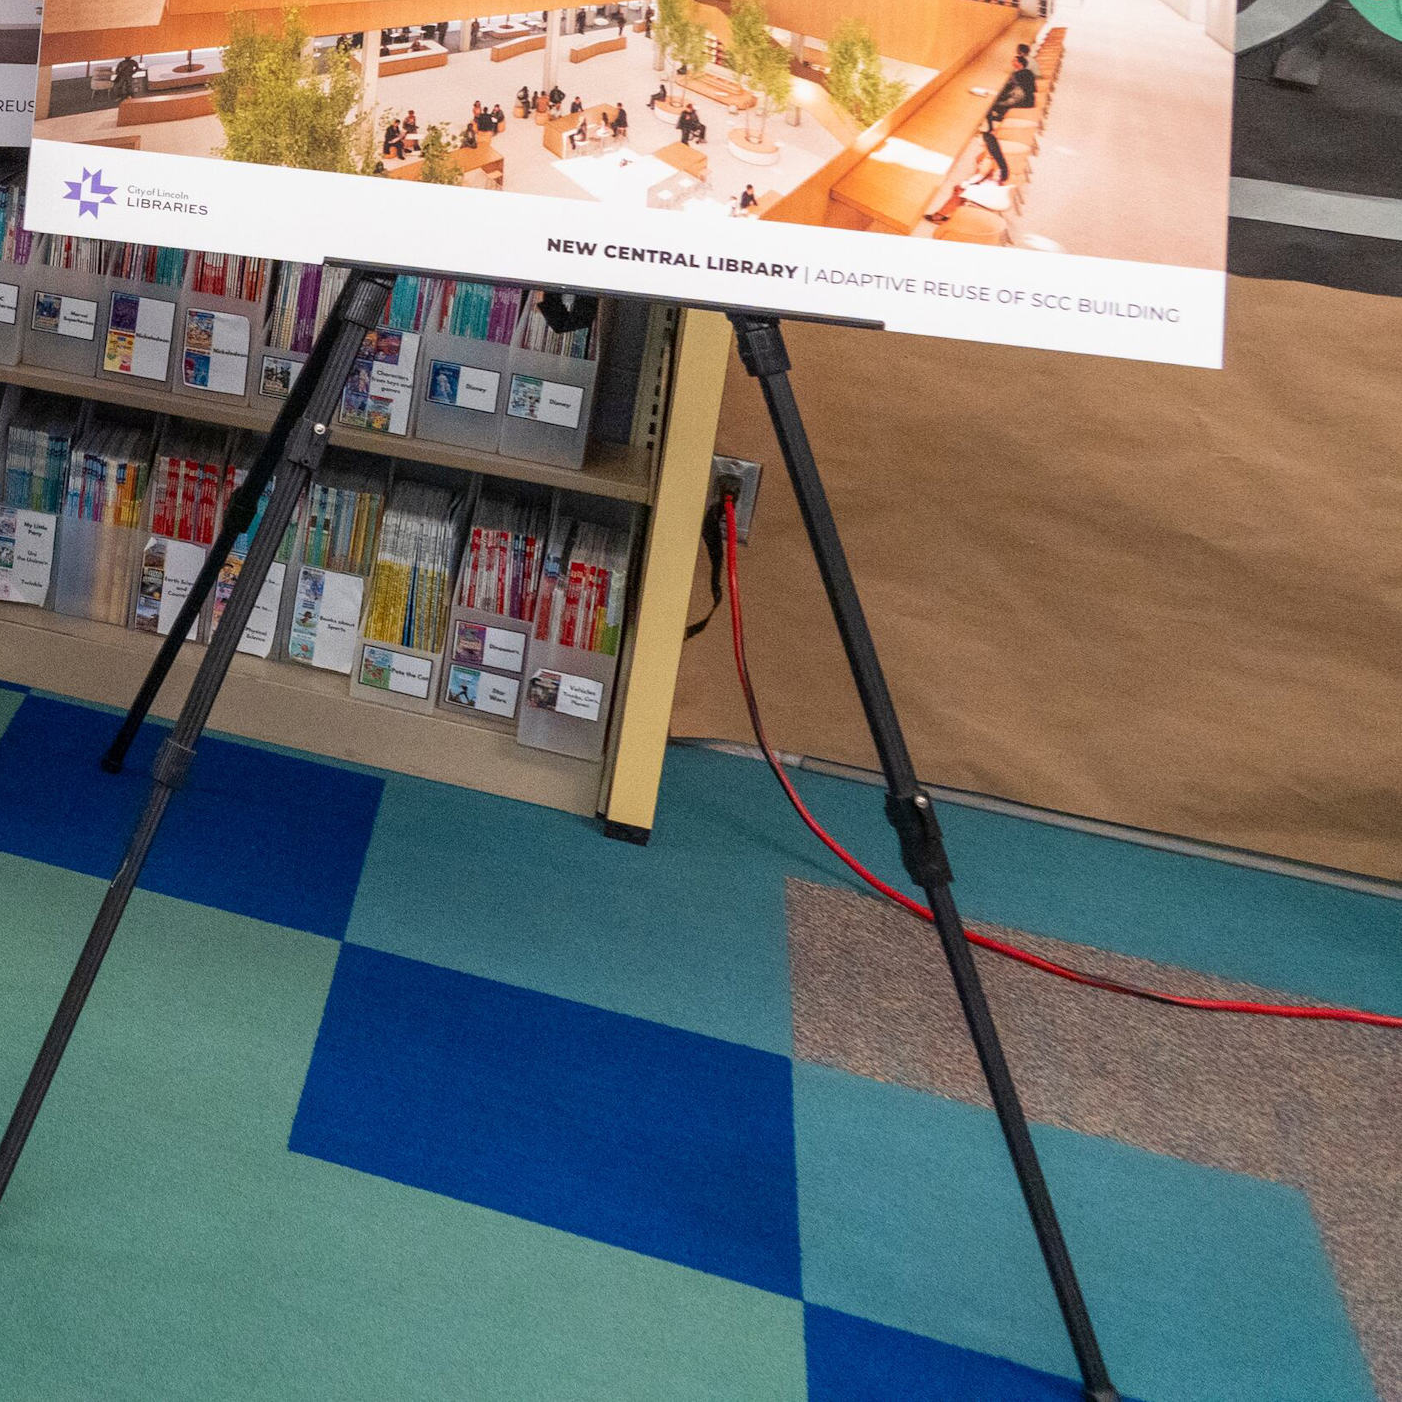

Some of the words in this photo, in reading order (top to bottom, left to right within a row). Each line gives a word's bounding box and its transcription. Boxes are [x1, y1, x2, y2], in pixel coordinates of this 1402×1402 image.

[127, 184, 146, 197] City
[146, 188, 155, 196] of
[157, 189, 189, 200] Lincoln
[127, 197, 208, 216] LIBRARIES
[546, 237, 598, 256] NEW
[603, 244, 700, 269] CENTRAL
[706, 255, 799, 279] LIBRARY
[815, 268, 917, 293] ADAPTIVE
[923, 280, 990, 302] REUSE
[996, 288, 1025, 305] OF
[1031, 292, 1072, 312] SCC
[1077, 297, 1181, 324] BUILDING
